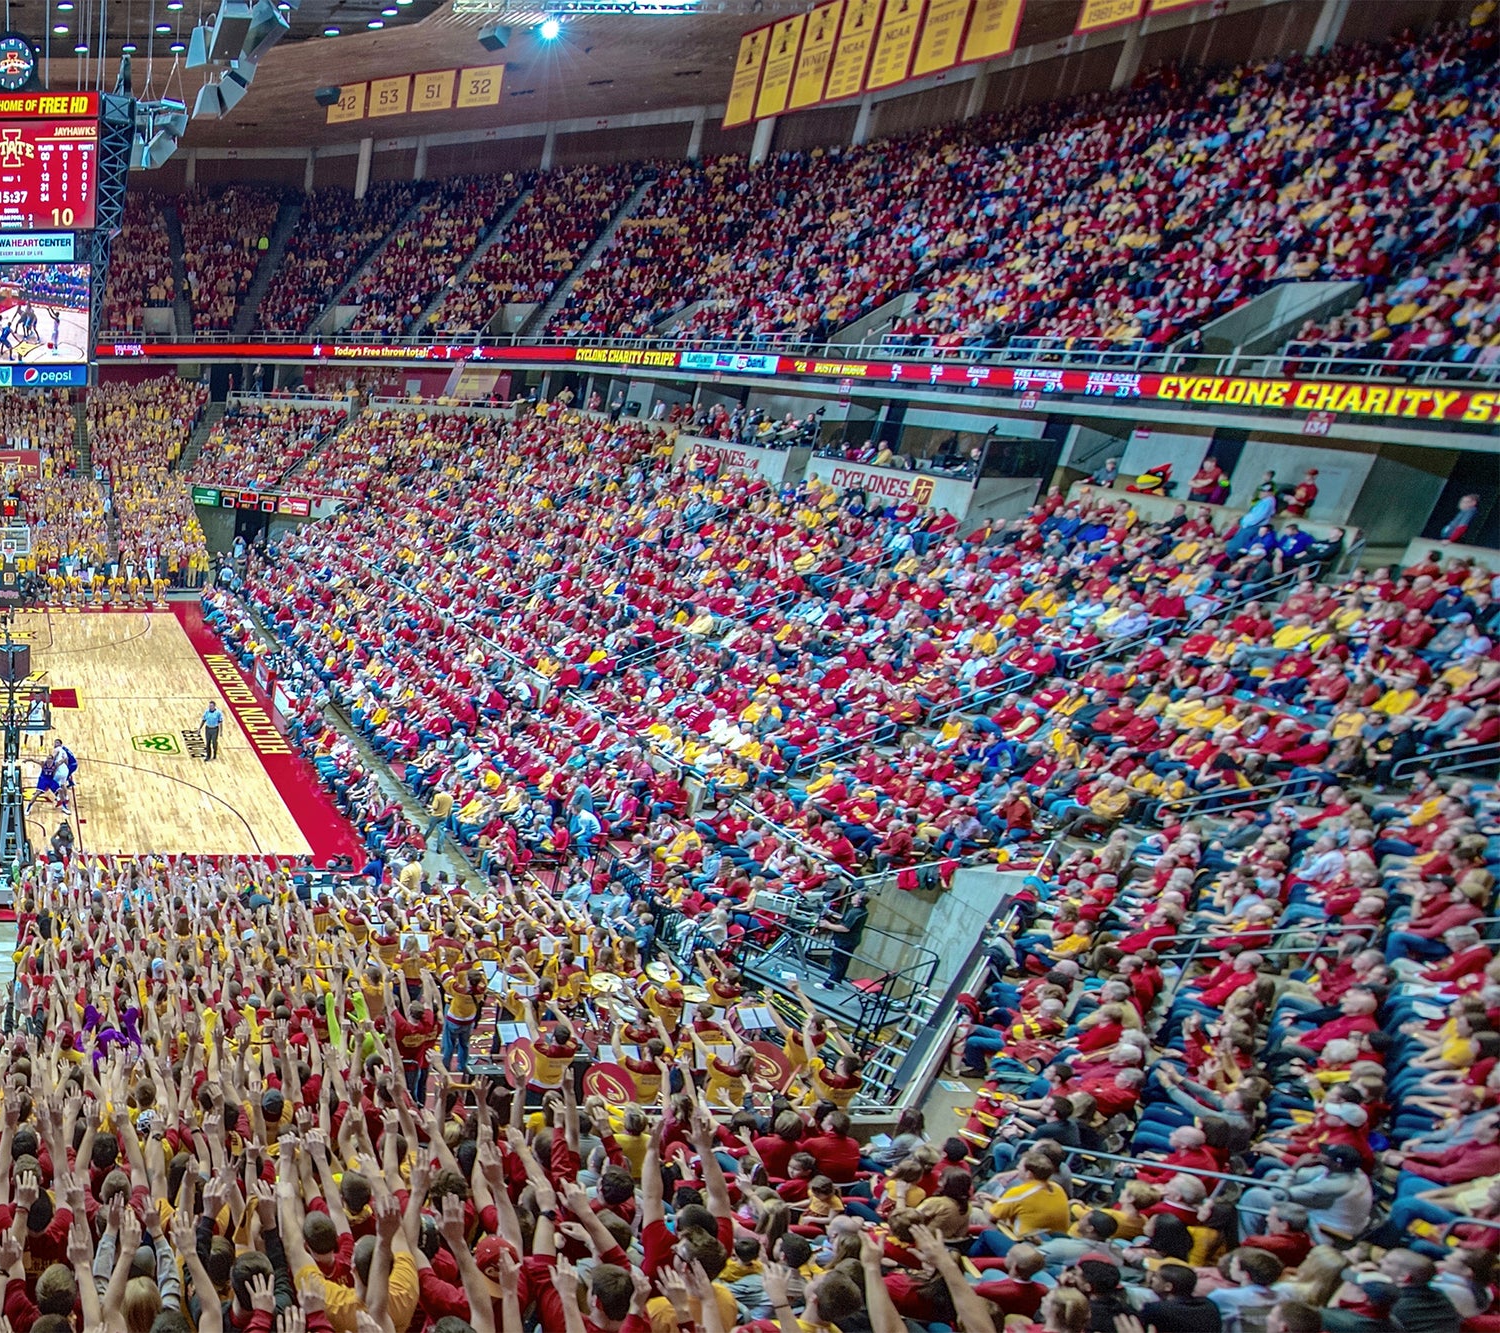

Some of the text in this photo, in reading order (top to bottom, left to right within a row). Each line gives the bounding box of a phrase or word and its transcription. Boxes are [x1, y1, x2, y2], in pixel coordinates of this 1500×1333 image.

[425, 84, 440, 99] 51
[469, 79, 491, 95] 32
[338, 96, 356, 110] 42
[380, 89, 399, 105] 53
[25, 99, 37, 112] OF
[38, 97, 68, 114] FREE
[70, 97, 88, 113] HD
[54, 126, 96, 136] JAYHAWKS
[41, 152, 50, 161] 00
[62, 152, 68, 161] 0
[82, 161, 88, 171] 0
[62, 172, 68, 181] 0
[82, 172, 87, 181] 0
[62, 182, 67, 191] 0
[81, 182, 87, 191] 0
[81, 192, 87, 202] 7
[51, 208, 74, 226] 10
[334, 346, 362, 357] Today's
[363, 346, 380, 356] Free
[381, 346, 405, 356] throw
[576, 348, 675, 367] CYCLONE CHARITY STRIPE
[814, 363, 841, 374] DUSTIN
[1014, 369, 1032, 379] FREE
[40, 370, 72, 383] pepsi
[1156, 376, 1500, 424] CYCLONE CHARITY S
[1305, 422, 1328, 434] 134
[203, 654, 292, 754] HILTON COLISEUM
